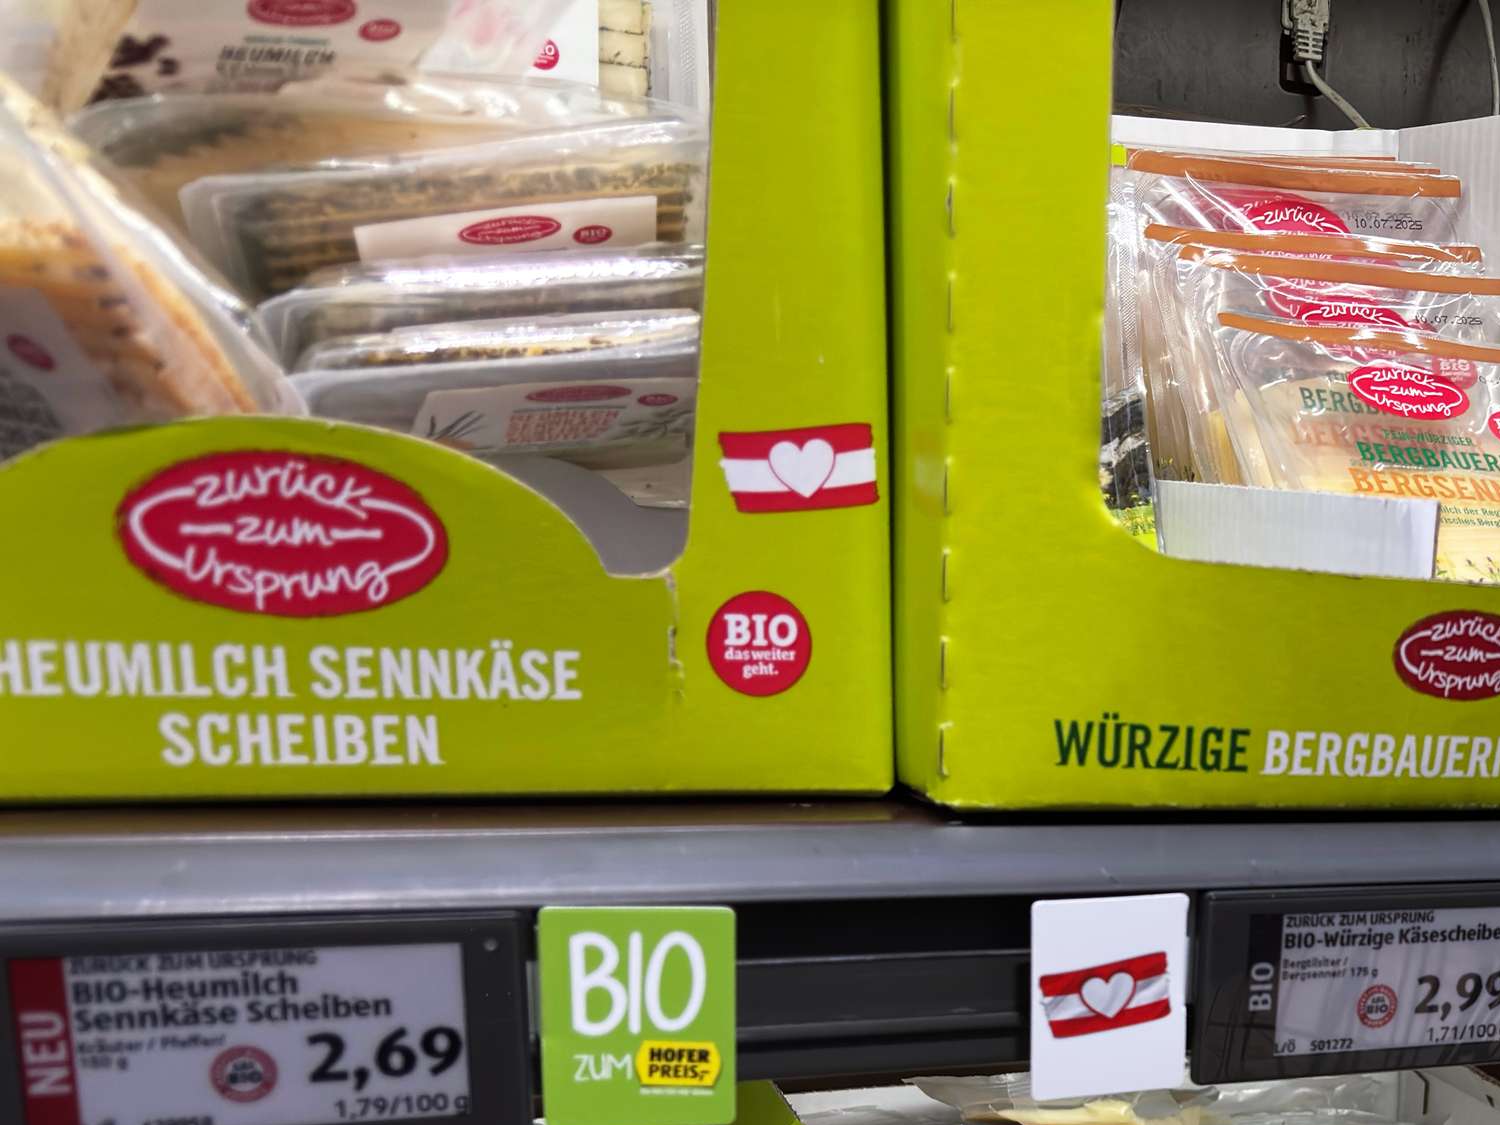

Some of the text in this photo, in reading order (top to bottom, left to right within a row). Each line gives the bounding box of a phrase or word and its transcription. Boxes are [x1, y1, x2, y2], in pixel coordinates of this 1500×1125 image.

[1354, 218, 1423, 231] 10.07.2025
[1371, 370, 1436, 389] zurück
[1390, 386, 1424, 396] zum
[1374, 394, 1452, 416] Ursprung
[191, 461, 373, 519] zurück
[236, 518, 332, 547] zum
[181, 548, 390, 610] Ursprung
[724, 615, 797, 648] BIO
[311, 641, 582, 701] SENNKÄSE
[724, 648, 796, 662] das weiter
[743, 663, 779, 679] geht.
[160, 713, 444, 766] SCHEIBEN
[1055, 712, 1250, 774] WÜRZIGE
[1370, 911, 1435, 926] URSPRUNG
[1284, 929, 1393, 950] BIO-Würzige
[73, 973, 298, 1005] BIO-Heumilch
[569, 930, 707, 1037] BIO
[1249, 962, 1275, 1012] BIO
[75, 996, 392, 1032] Sennkäse Scheiben
[1427, 1024, 1496, 1042] 1,71/100
[21, 1009, 72, 1095] NEU
[308, 1026, 462, 1091] 2,69
[574, 1046, 710, 1083] ZUM HOFER
[334, 1095, 448, 1119] 1,79/100
